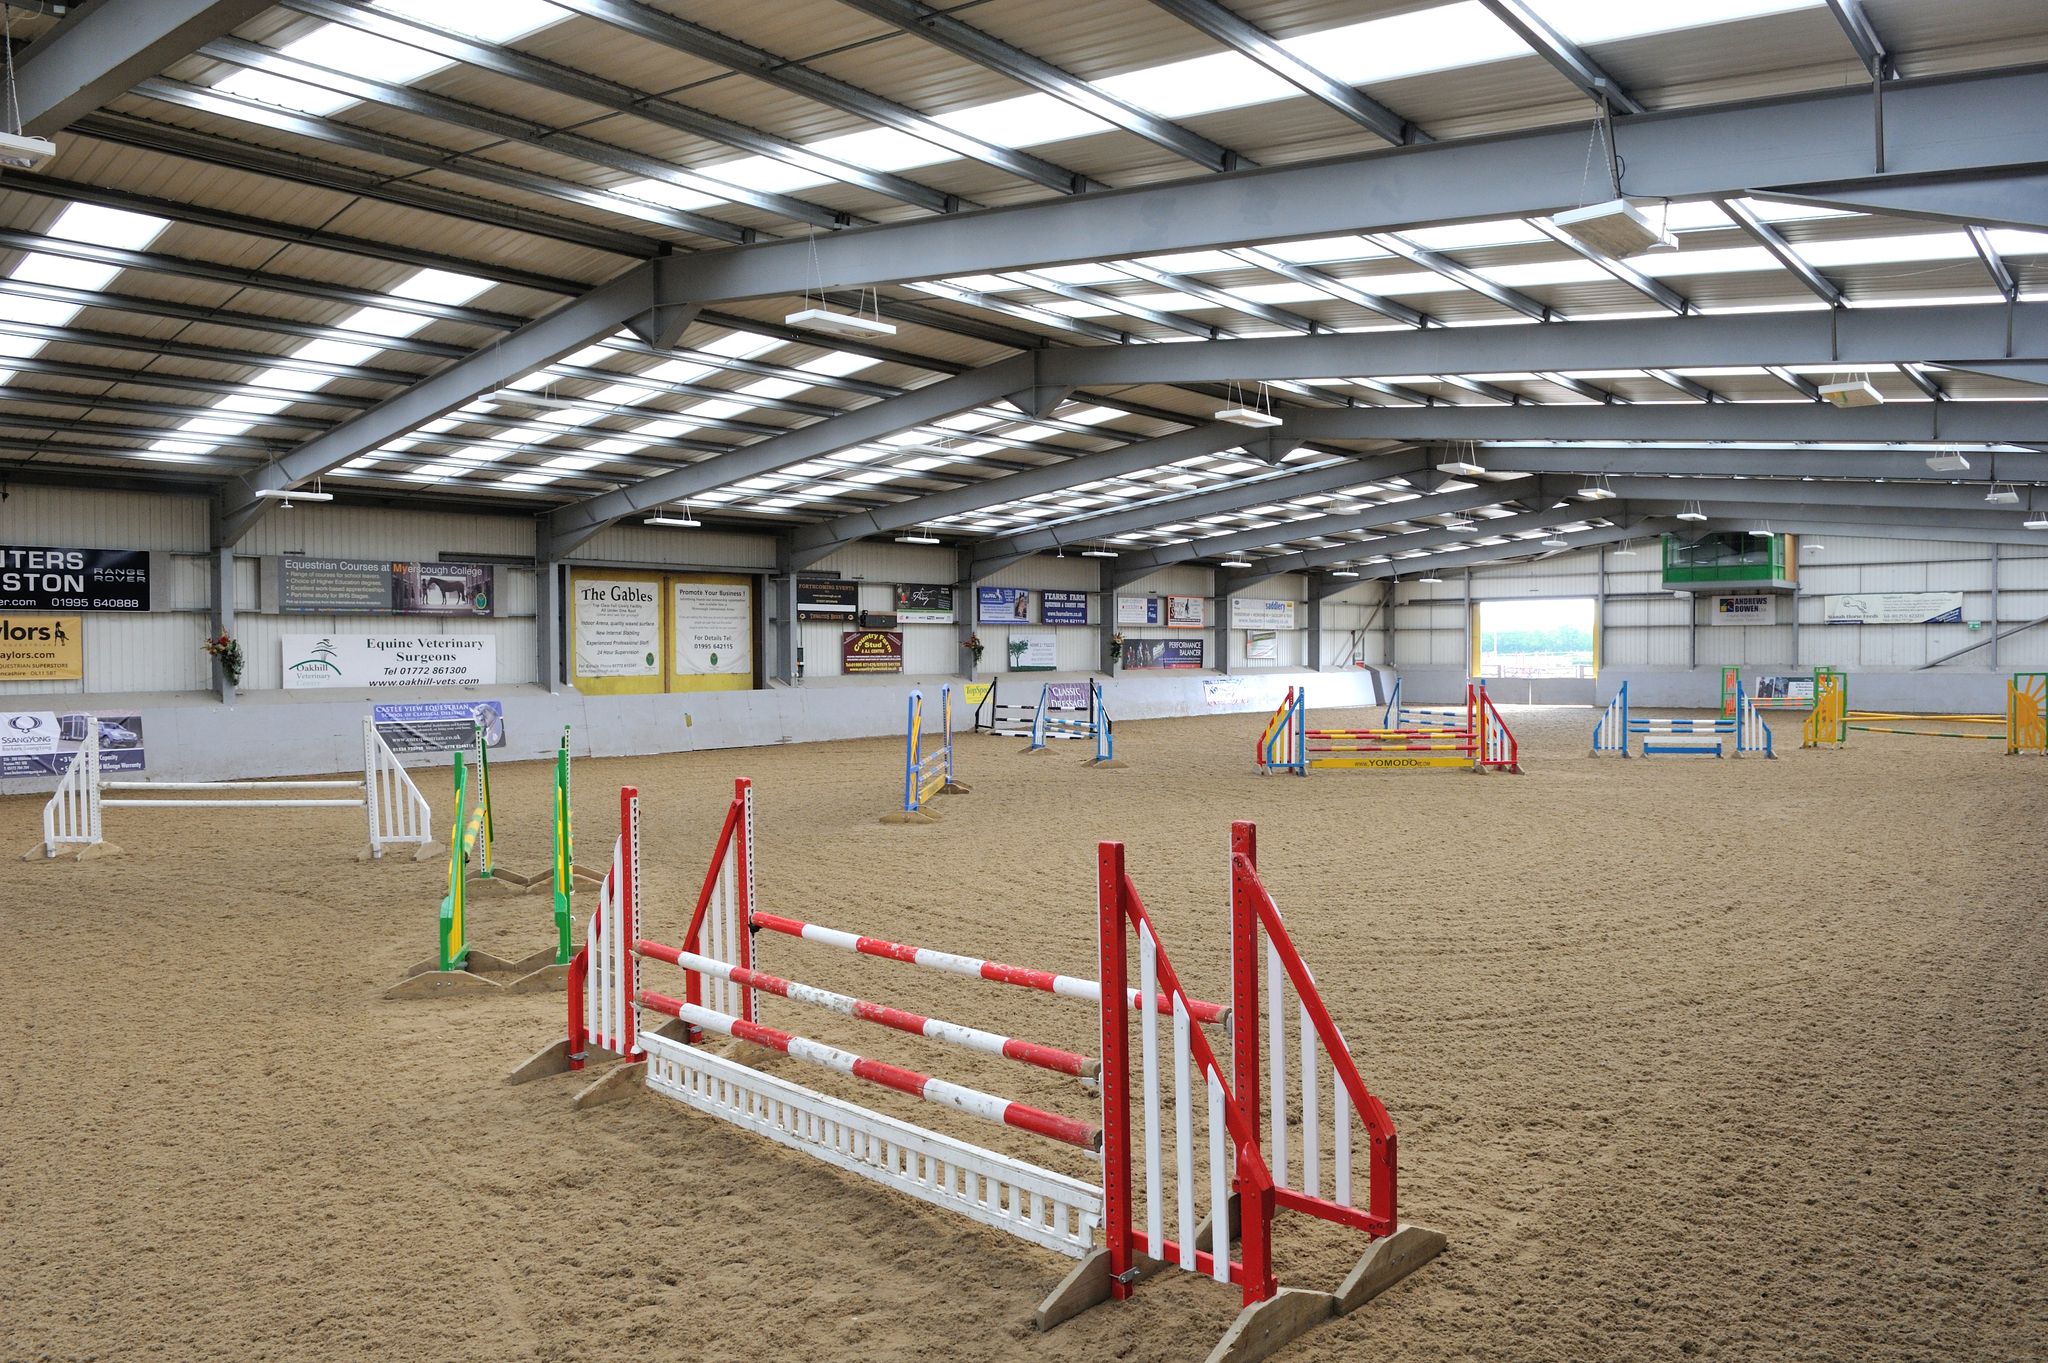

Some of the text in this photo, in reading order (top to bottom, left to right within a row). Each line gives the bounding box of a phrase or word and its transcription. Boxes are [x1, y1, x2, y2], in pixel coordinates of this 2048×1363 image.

[285, 559, 390, 571] Equestrian Courses at
[93, 567, 145, 576] RANGE
[393, 563, 482, 577] Myerscough College
[93, 575, 147, 584] ROVER
[581, 585, 653, 602] The Gables
[1044, 592, 1086, 601] FEARNS FARM
[51, 598, 89, 608] 01995
[93, 599, 139, 608] 640888
[1734, 597, 1767, 605] ANDREWS
[367, 638, 485, 651] Equine Veterinary
[853, 633, 892, 653] Country Farm
[1168, 641, 1202, 649] PERFORMANCE
[1179, 649, 1202, 657] BALANCER
[396, 652, 457, 664] Surgeons
[296, 664, 328, 672] Oakhill
[384, 666, 467, 675] Tel 01772 861300
[296, 672, 331, 680] Veterinary
[369, 677, 480, 687] www.oakhill-vets.com
[1052, 686, 1081, 697] CLASSIC
[425, 704, 469, 712] EQUESTRIAN
[1051, 699, 1086, 708] DRESSAGE
